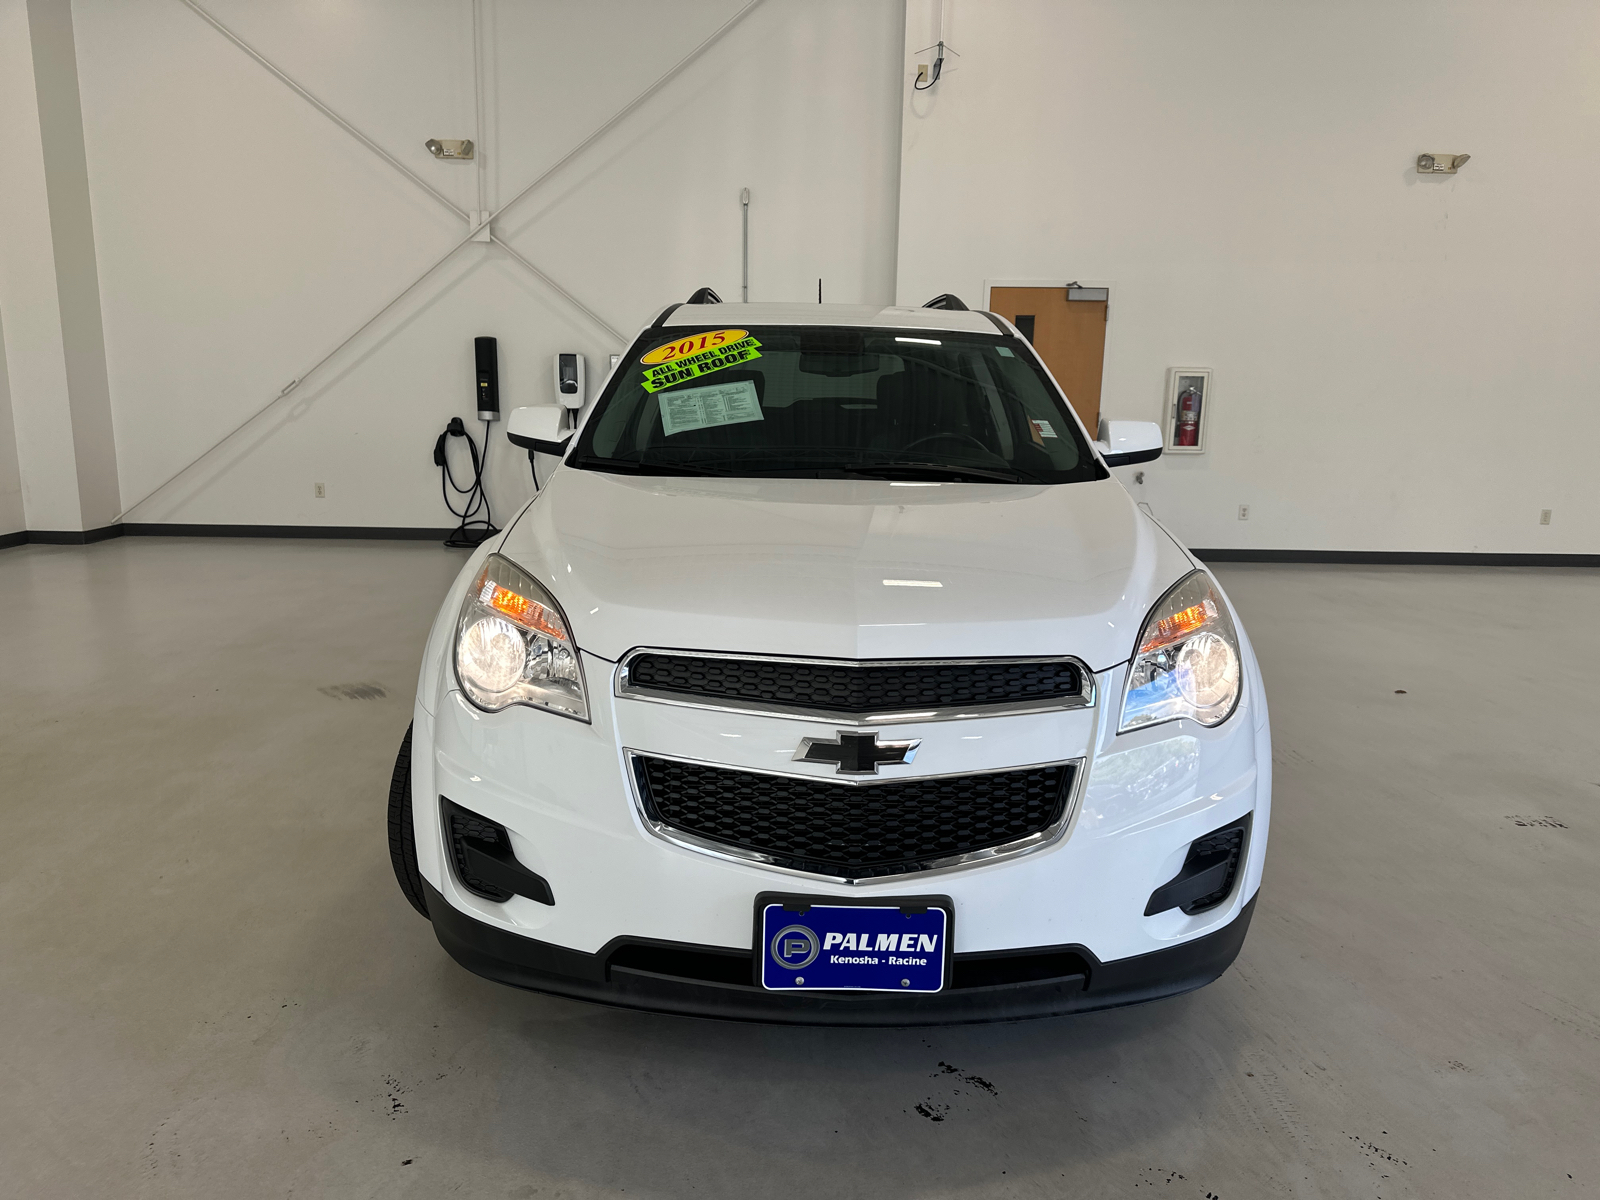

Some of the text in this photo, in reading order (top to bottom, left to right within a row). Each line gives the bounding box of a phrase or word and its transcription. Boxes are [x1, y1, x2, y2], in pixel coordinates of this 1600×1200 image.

[652, 339, 755, 377] ALL WHEEL DRIVE
[662, 332, 726, 361] 2015
[651, 350, 751, 389] SUN ROOF
[823, 932, 938, 952] PALMEN
[830, 955, 878, 965] Kenosha
[888, 956, 927, 966] Racine
